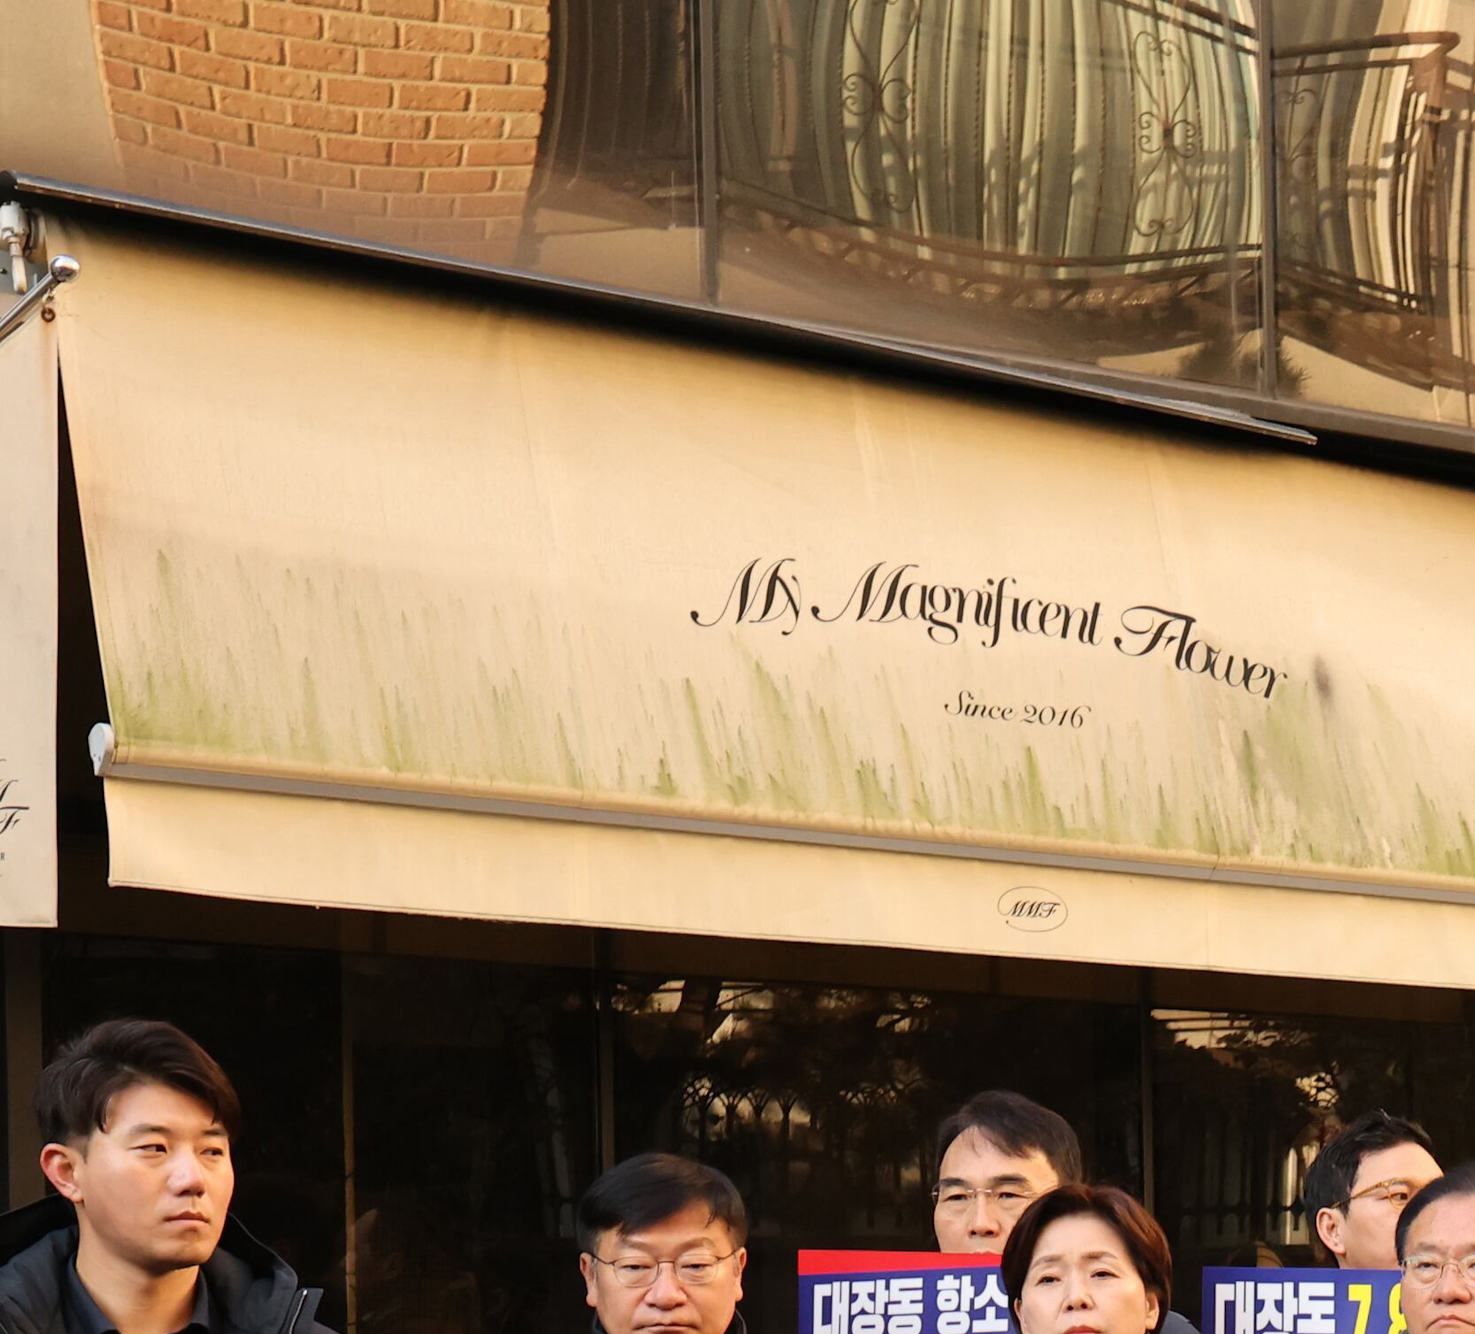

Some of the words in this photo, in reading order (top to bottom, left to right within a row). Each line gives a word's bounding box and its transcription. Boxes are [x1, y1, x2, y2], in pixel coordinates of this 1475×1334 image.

[691, 557, 799, 635] My
[811, 561, 1102, 649] Magnificent
[1113, 605, 1288, 700] Flower
[944, 690, 1014, 723] Since
[1023, 703, 1091, 730] 2016
